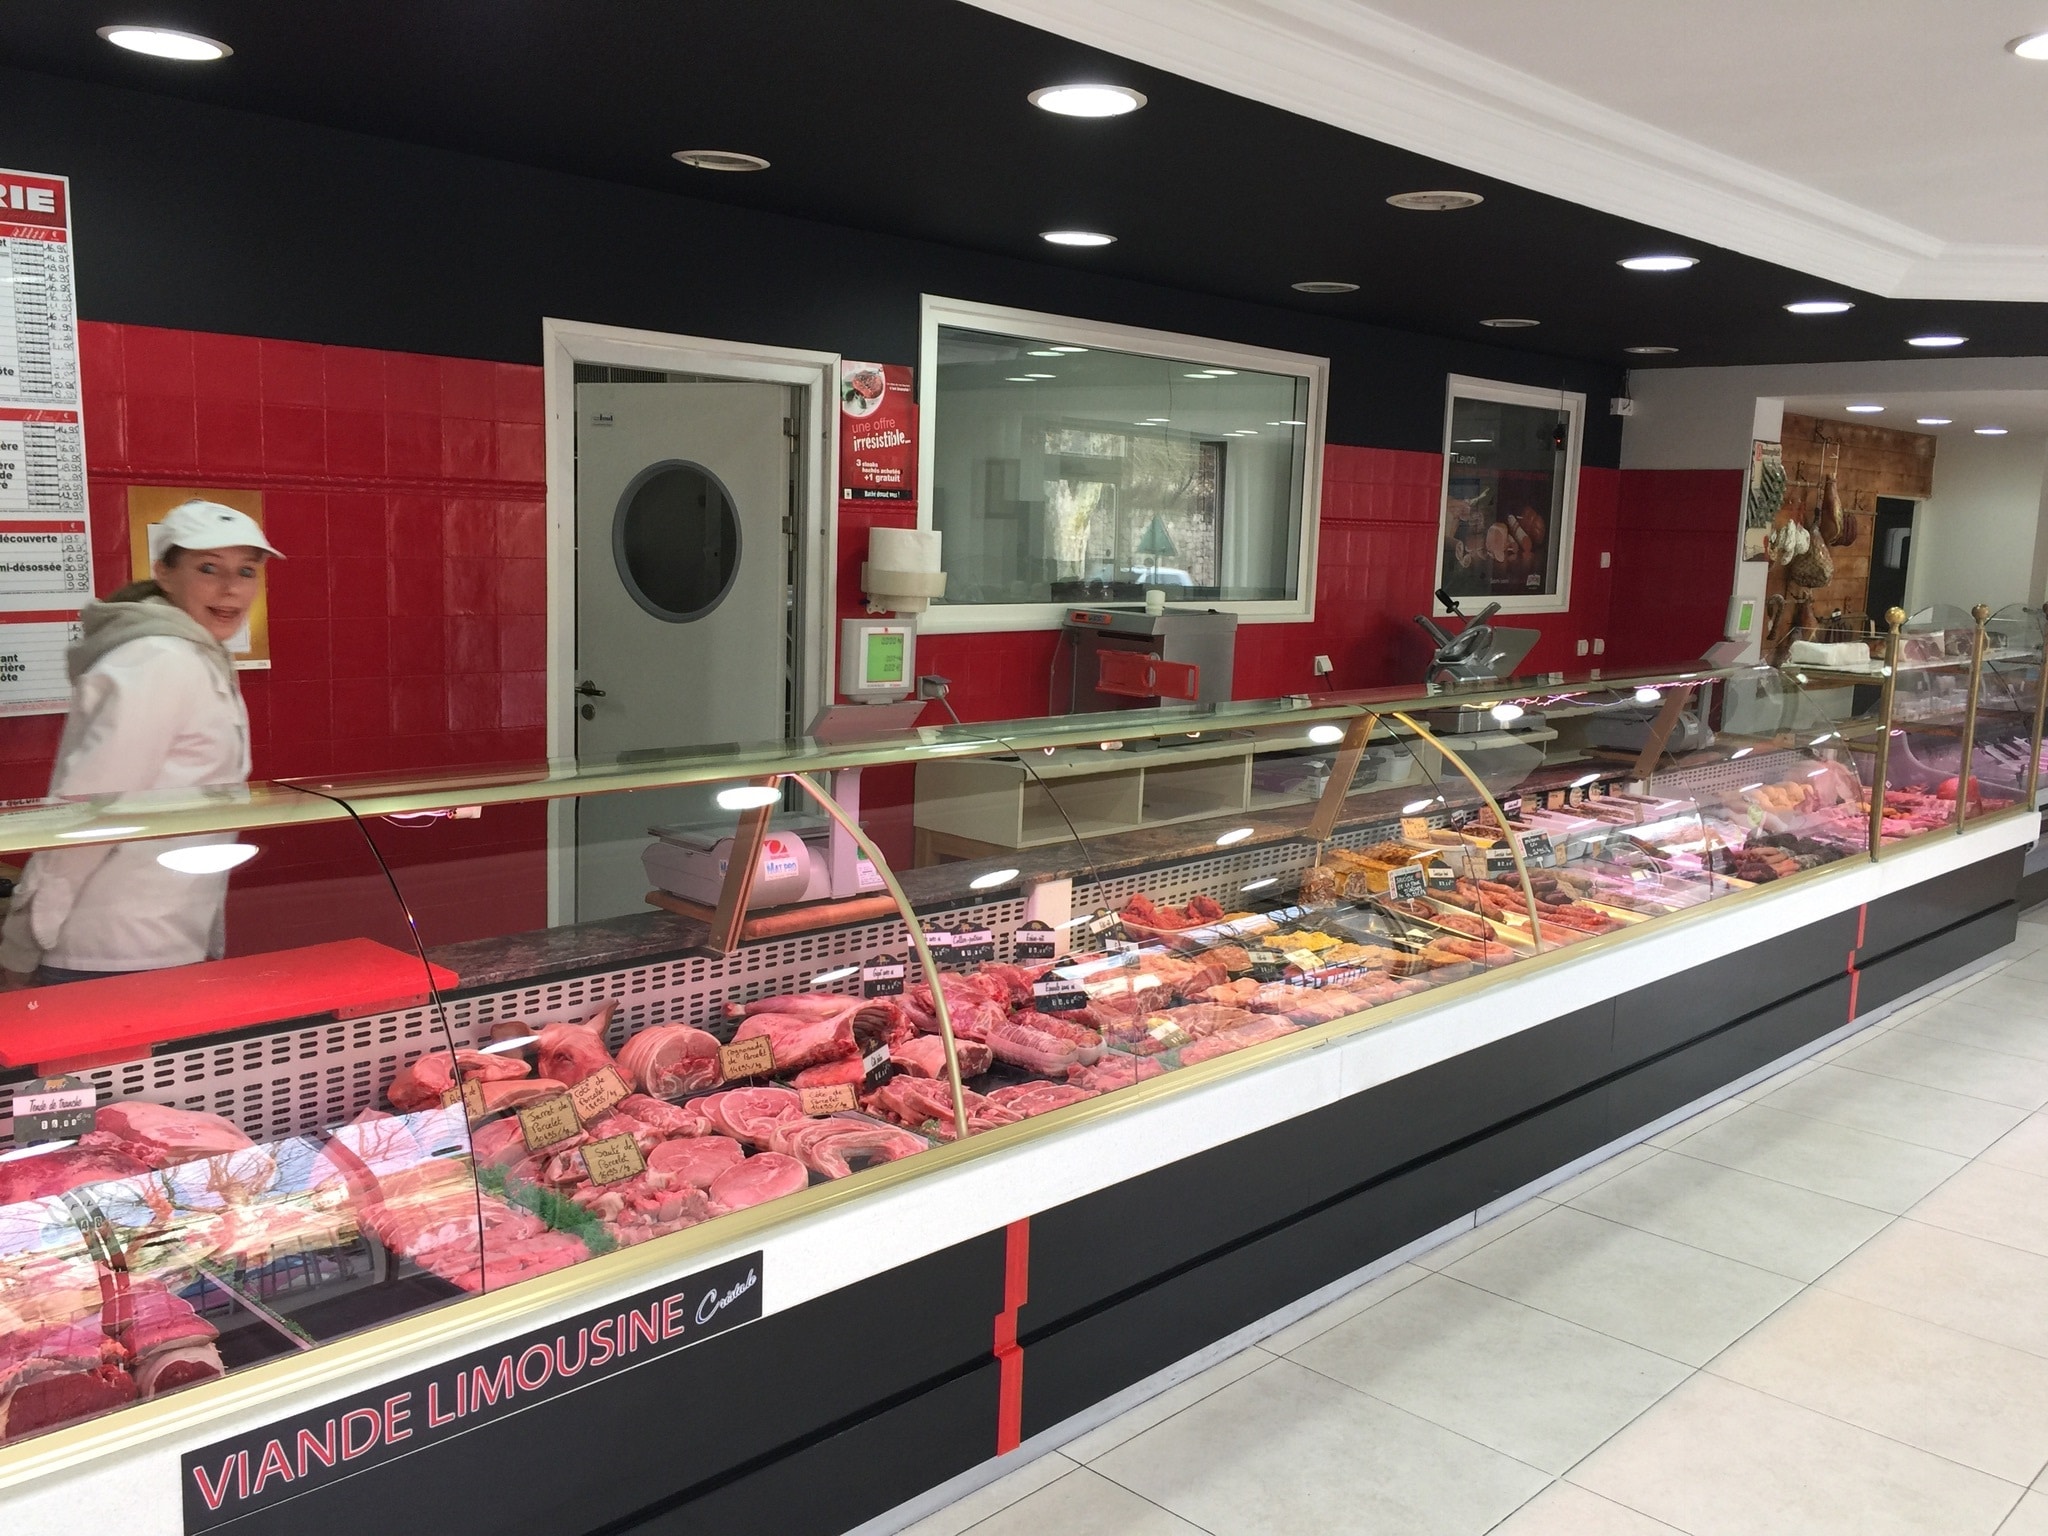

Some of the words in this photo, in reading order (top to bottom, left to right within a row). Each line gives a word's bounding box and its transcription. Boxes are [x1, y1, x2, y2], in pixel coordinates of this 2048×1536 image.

[851, 422, 871, 434] une
[873, 417, 896, 431] offre
[875, 474, 901, 483] gratuit
[192, 1391, 414, 1511] VIANDE
[426, 1292, 687, 1429] LIMOUSINE
